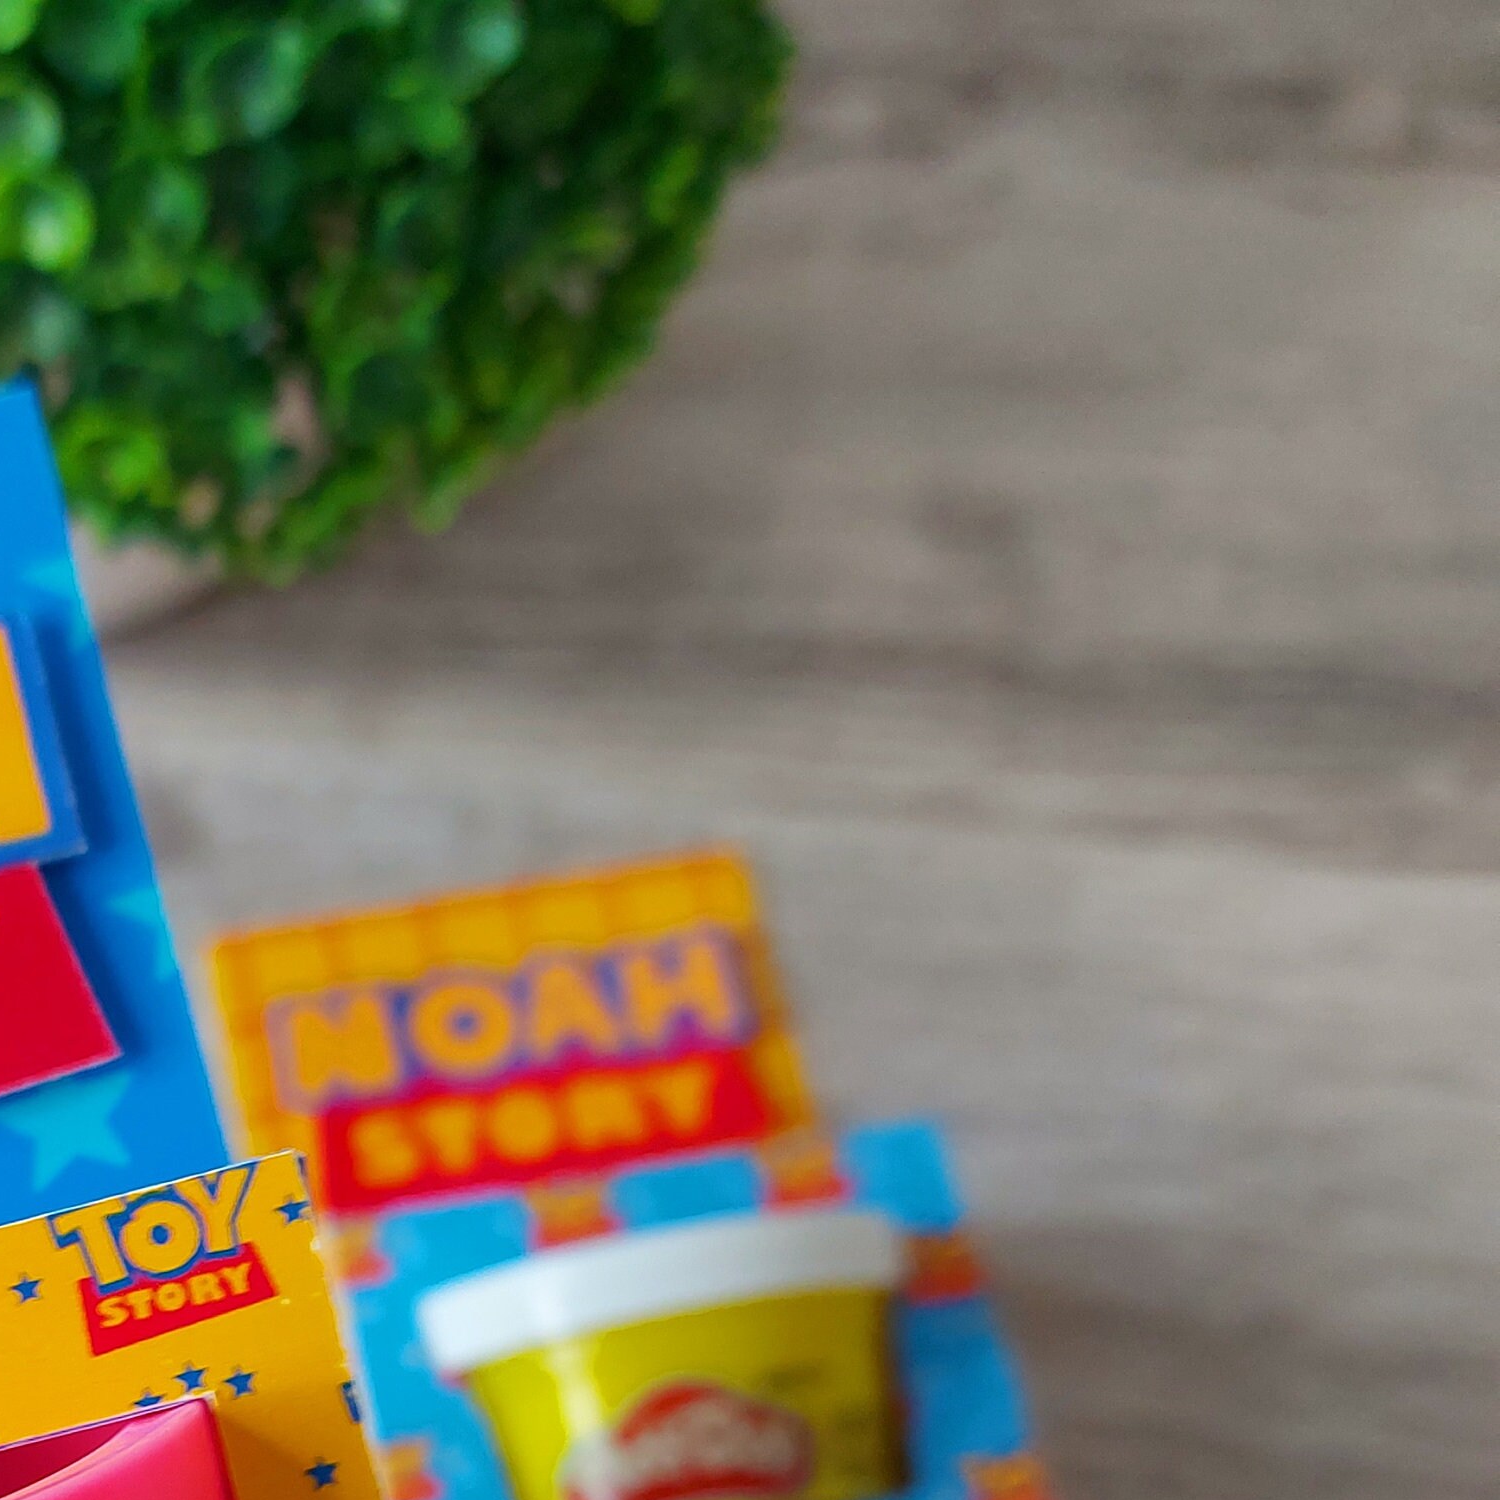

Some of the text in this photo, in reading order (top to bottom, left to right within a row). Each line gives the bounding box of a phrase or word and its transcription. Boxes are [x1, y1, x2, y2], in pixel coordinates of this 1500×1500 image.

[272, 926, 746, 1102] NOAH
[348, 1066, 716, 1189] STORY
[48, 1161, 261, 1292] TOY
[94, 1262, 252, 1329] STORY
